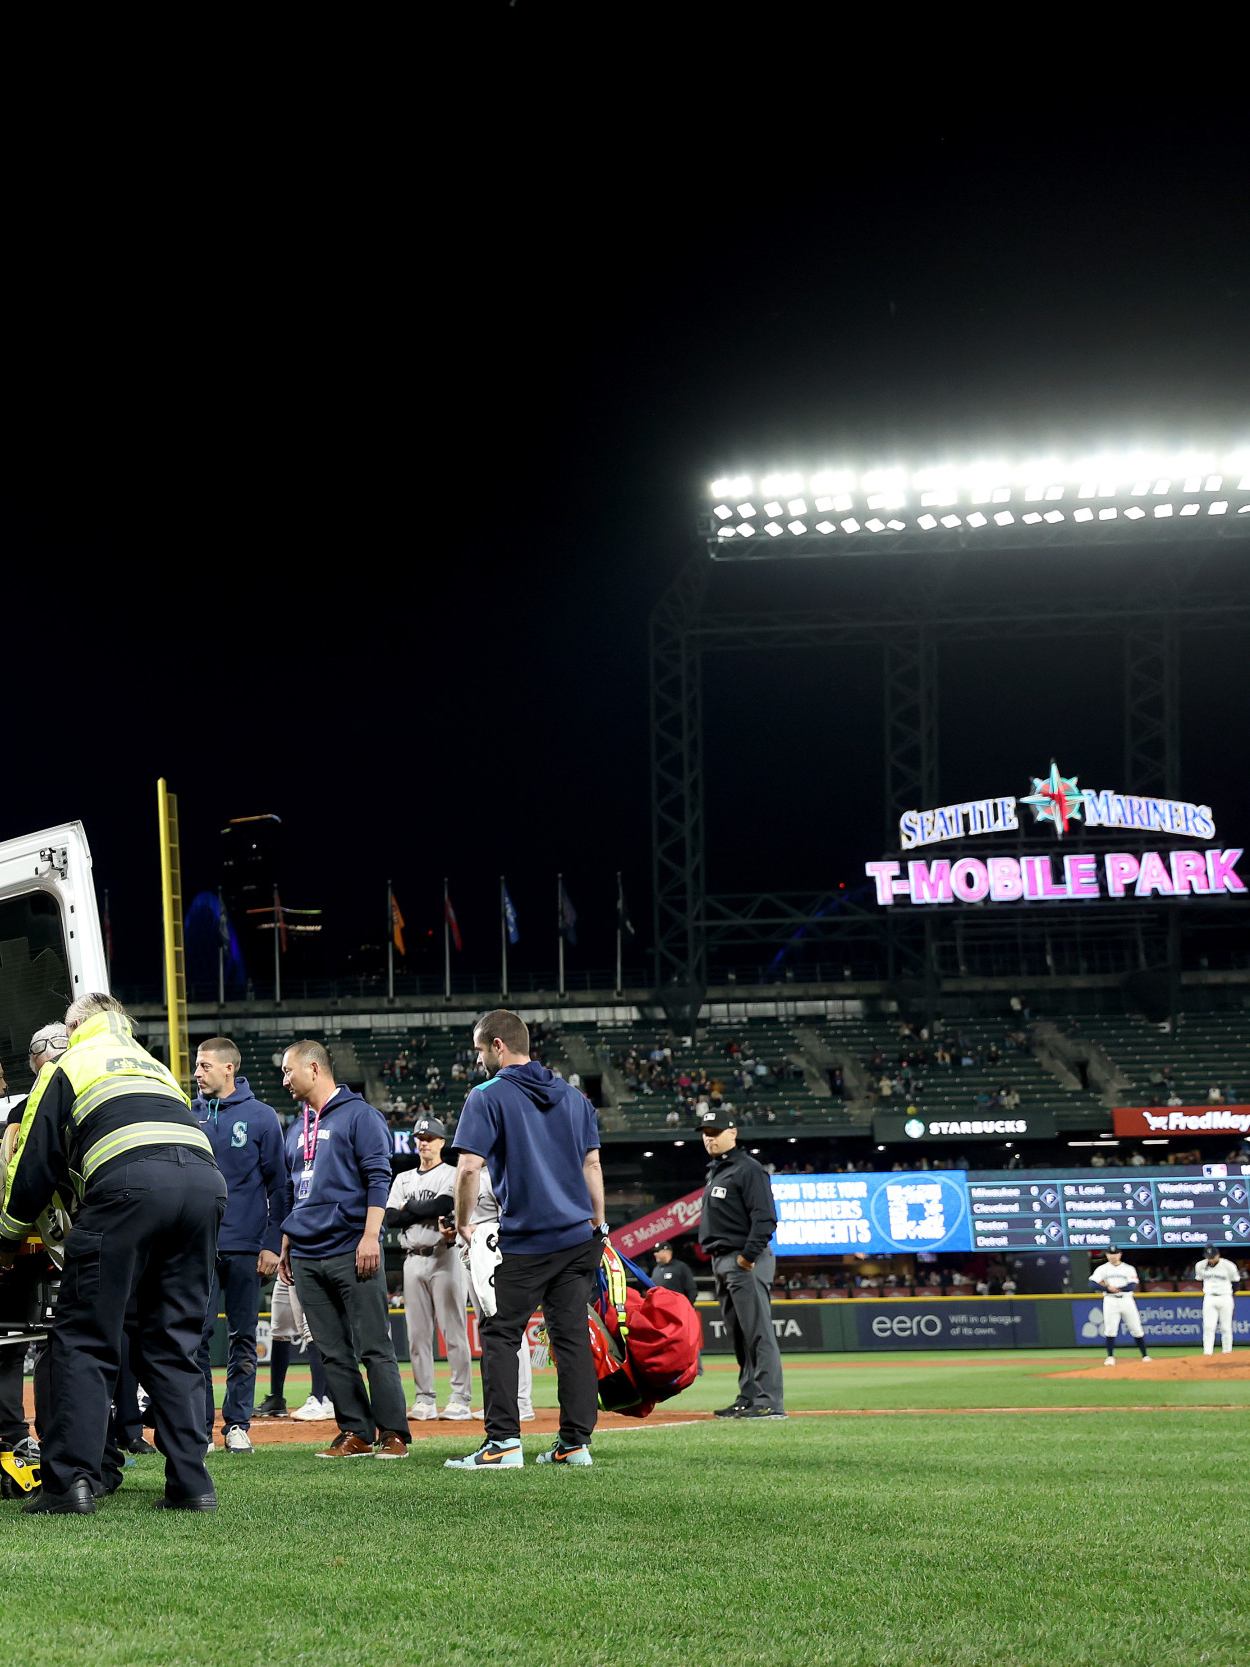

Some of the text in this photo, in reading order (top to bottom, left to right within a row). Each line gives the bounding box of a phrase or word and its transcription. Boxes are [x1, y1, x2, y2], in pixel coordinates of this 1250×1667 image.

[899, 789, 1216, 850] SEATTLE MARINERS
[865, 848, 1249, 906] T-MOBILE PARK
[928, 1119, 1028, 1135] STARBUCKS
[771, 1182, 868, 1200] SCAN TO SEE YOUR
[779, 1200, 863, 1220] MARINERS
[973, 1203, 1020, 1213] Cleveland
[634, 1217, 675, 1243] Mobile
[776, 1219, 871, 1245] MOMENTS
[1139, 1306, 1174, 1322] ginia
[872, 1315, 942, 1338] eero
